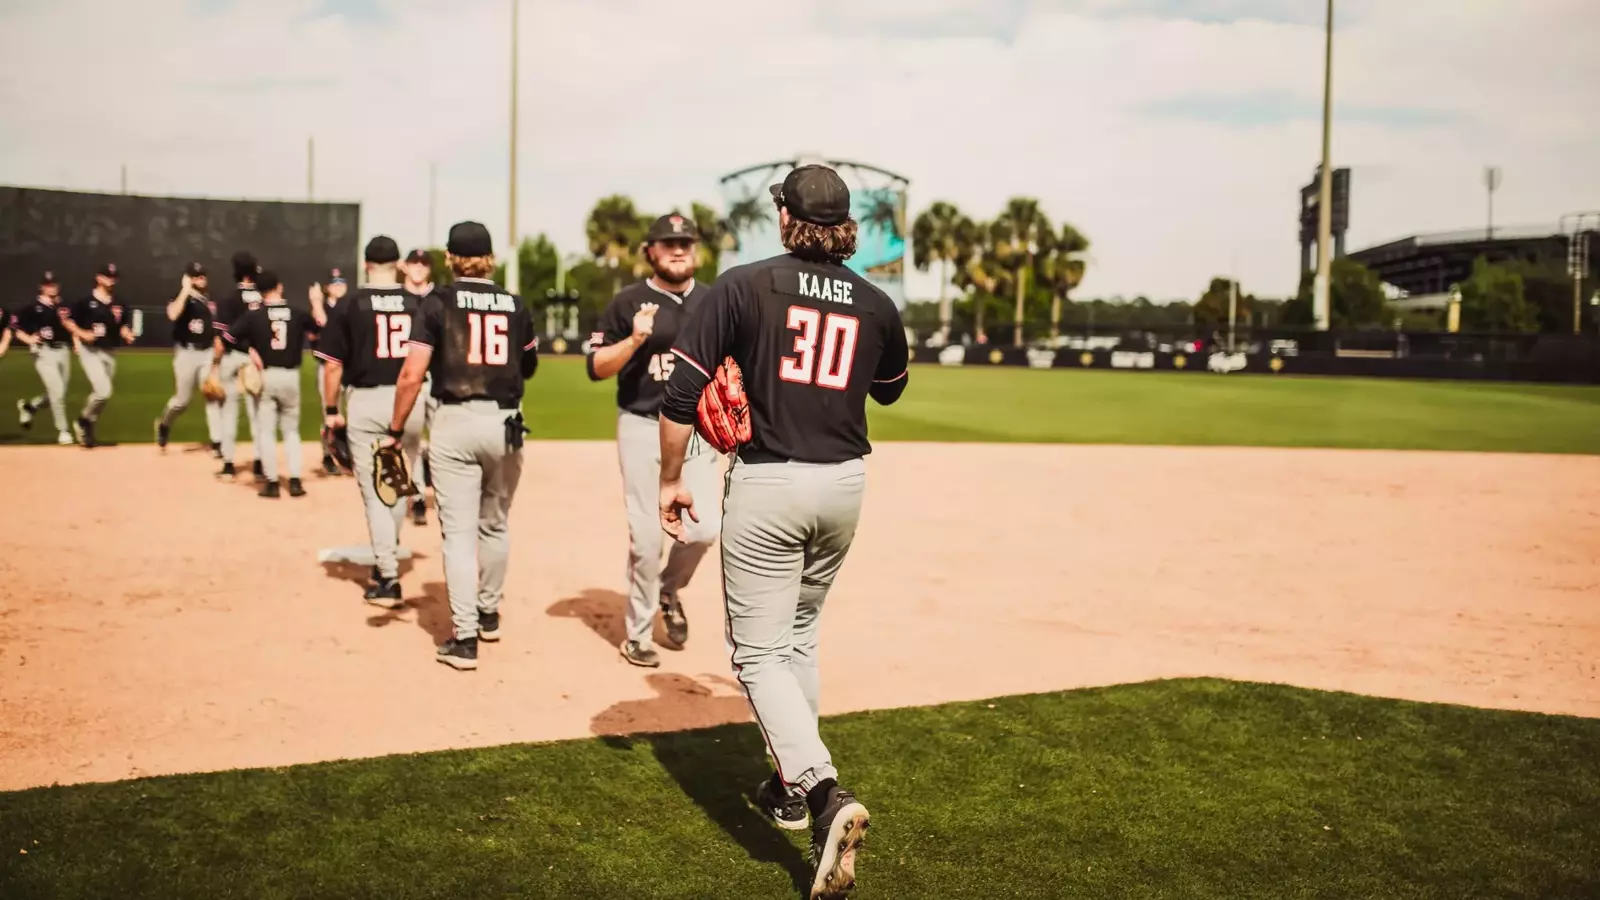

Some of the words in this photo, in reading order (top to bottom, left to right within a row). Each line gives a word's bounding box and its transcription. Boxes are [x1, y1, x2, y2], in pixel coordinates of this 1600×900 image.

[798, 272, 853, 305] KAASE
[270, 320, 288, 350] 3
[375, 313, 411, 359] 12
[467, 312, 509, 365] 16
[779, 305, 859, 390] 30
[648, 353, 676, 382] 45
